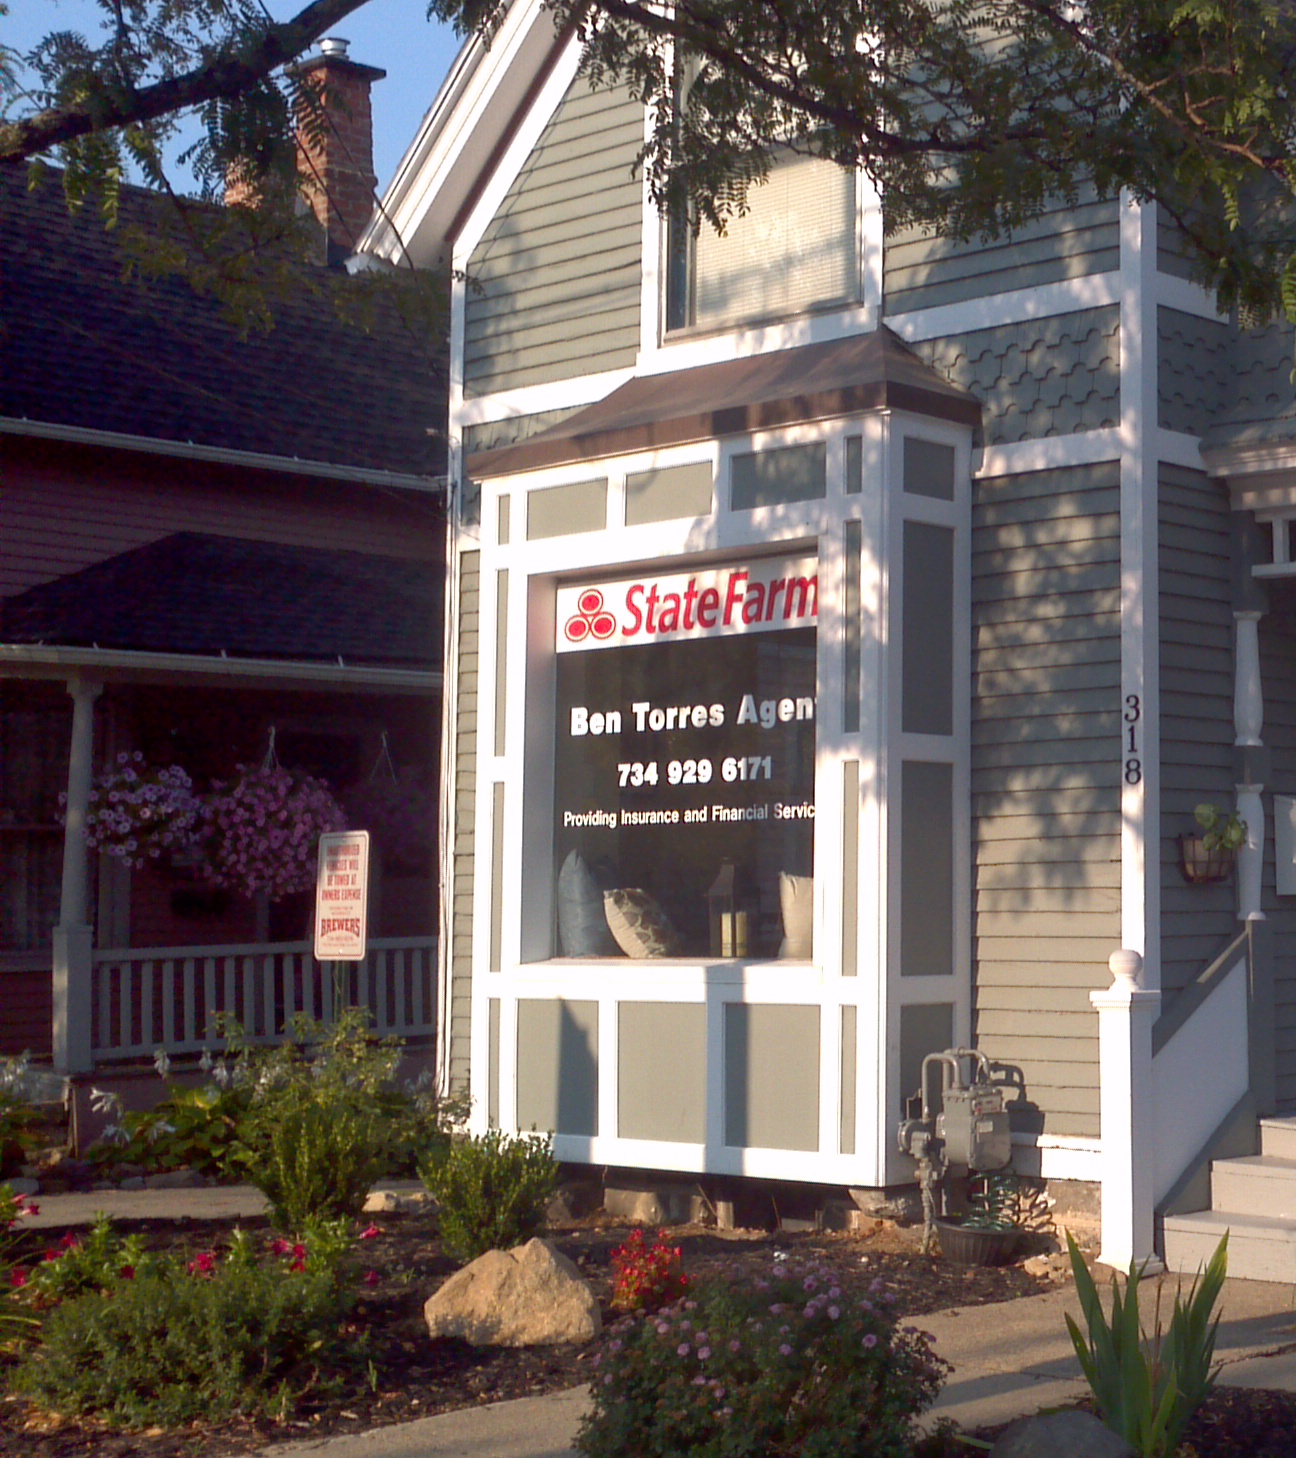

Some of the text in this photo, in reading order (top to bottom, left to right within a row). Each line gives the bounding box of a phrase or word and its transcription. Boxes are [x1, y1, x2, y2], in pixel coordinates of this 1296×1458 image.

[621, 572, 818, 636] StateFarm
[571, 693, 818, 736] Ben Torres Agen
[1124, 694, 1142, 785] 318
[618, 756, 772, 786] 734 929 6171
[564, 810, 617, 828] Providing
[621, 808, 679, 825] Insurance
[684, 806, 707, 822] and
[712, 803, 768, 821] Financial
[321, 918, 360, 937] BREWERS
